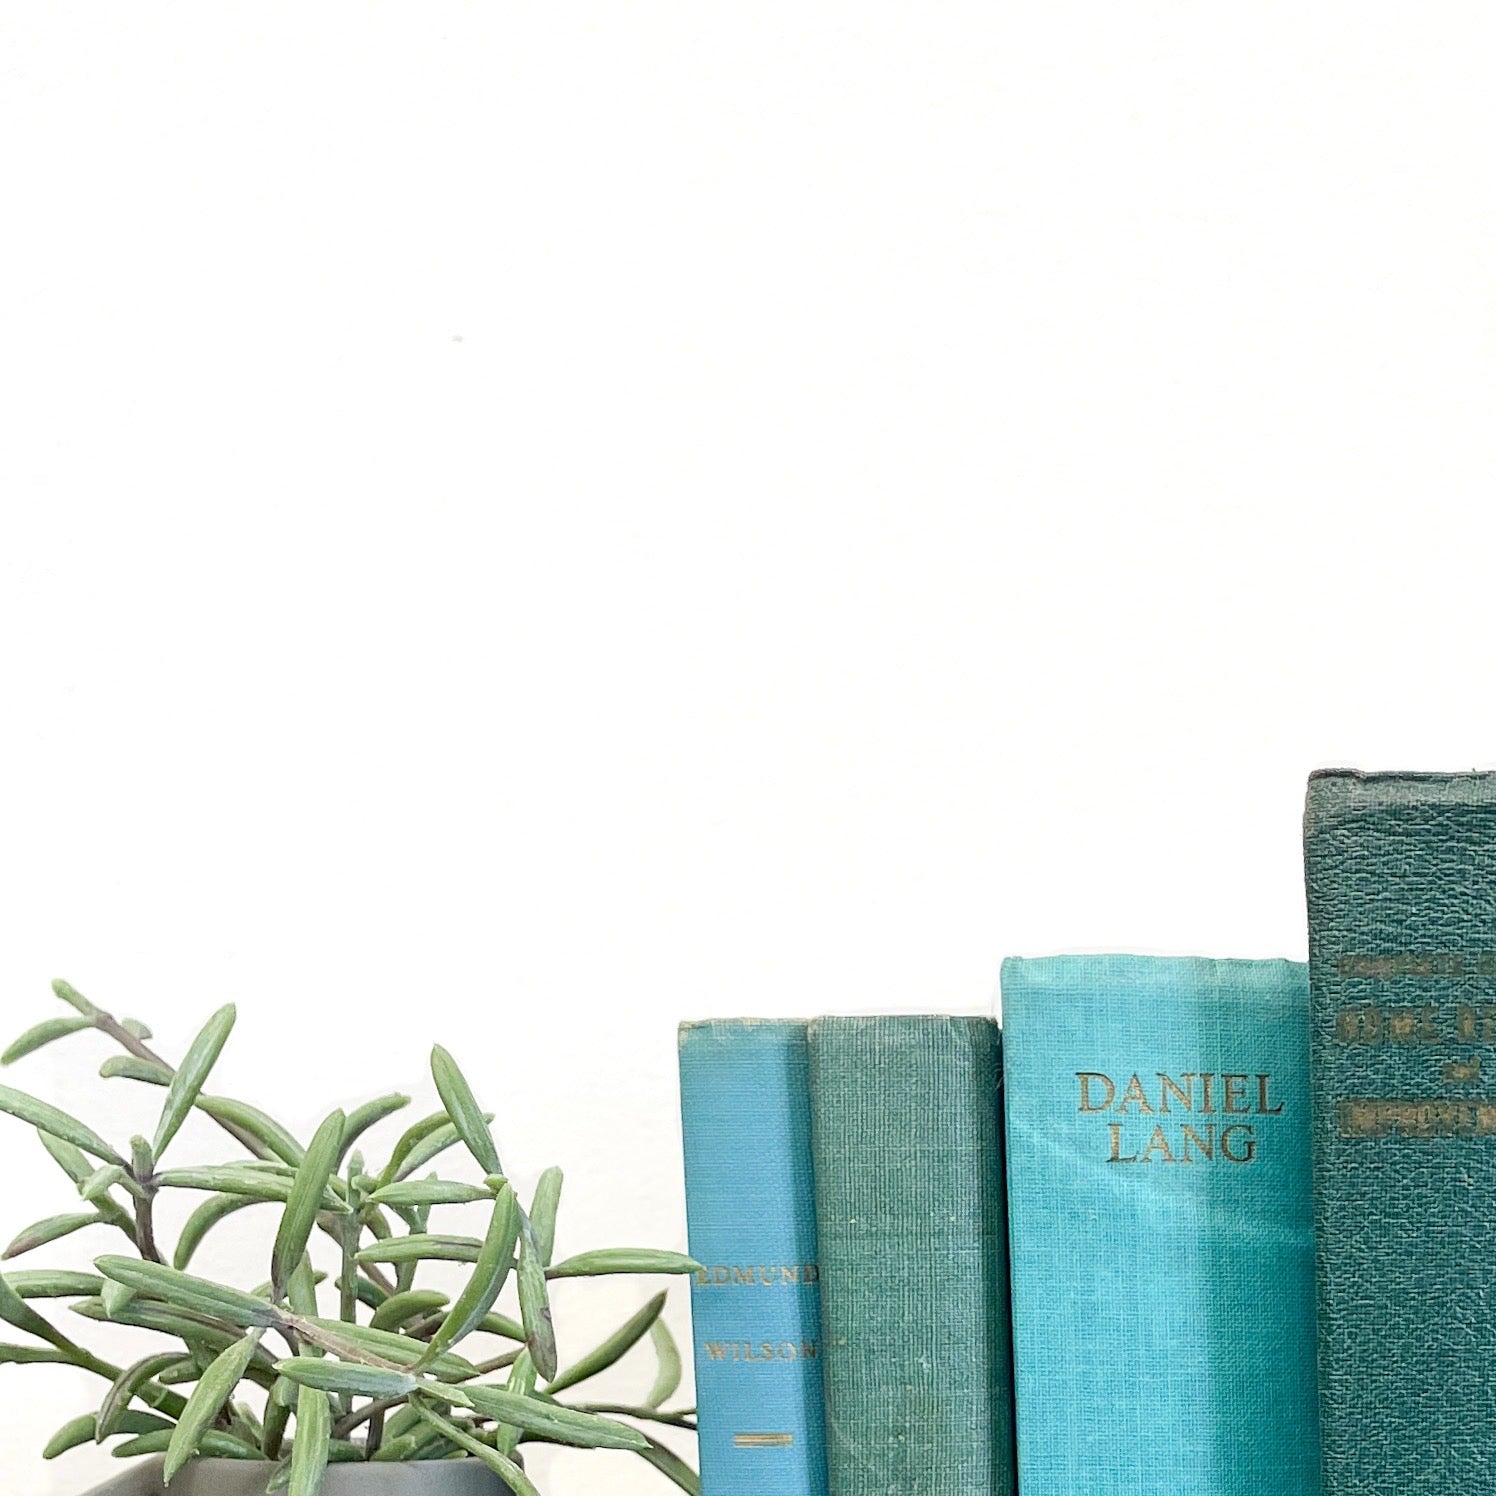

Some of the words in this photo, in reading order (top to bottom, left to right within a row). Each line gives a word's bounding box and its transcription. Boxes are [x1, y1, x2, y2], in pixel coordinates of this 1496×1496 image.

[1075, 1071, 1286, 1115] DANIEL
[1105, 1122, 1256, 1164] LANG
[695, 1263, 820, 1287] EDMUND
[704, 1340, 818, 1363] WILSON
